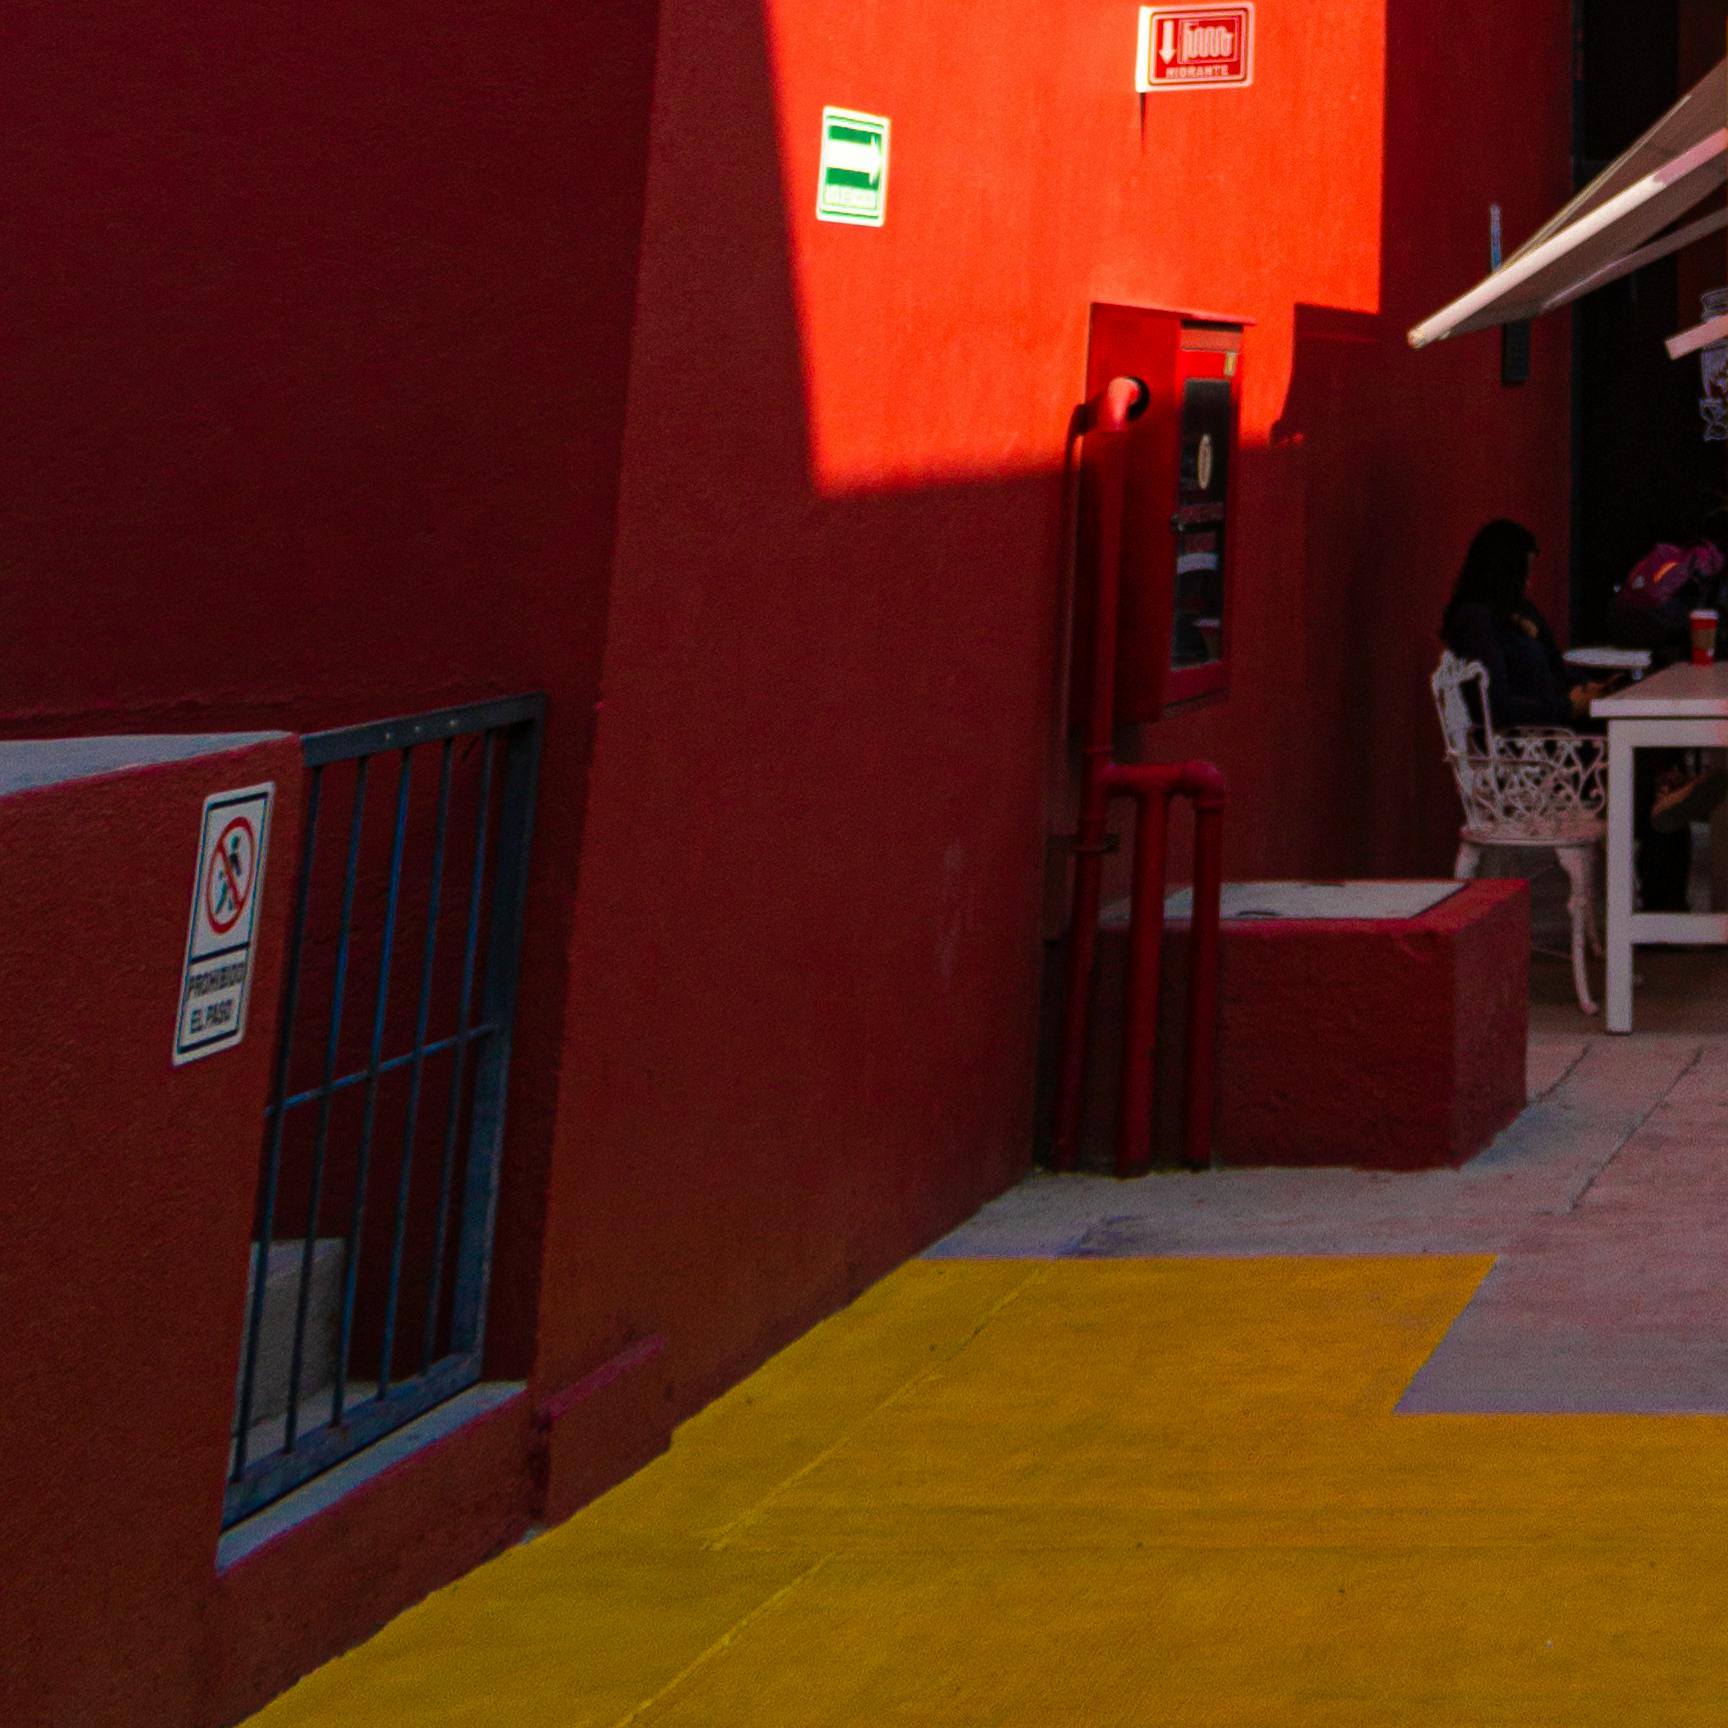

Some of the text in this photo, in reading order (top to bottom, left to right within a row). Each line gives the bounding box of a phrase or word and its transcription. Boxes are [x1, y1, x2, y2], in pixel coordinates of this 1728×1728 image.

[1166, 65, 1229, 78] HIDRANTE
[189, 961, 246, 996] PROHIBIDO
[190, 999, 233, 1034] EL PASO
